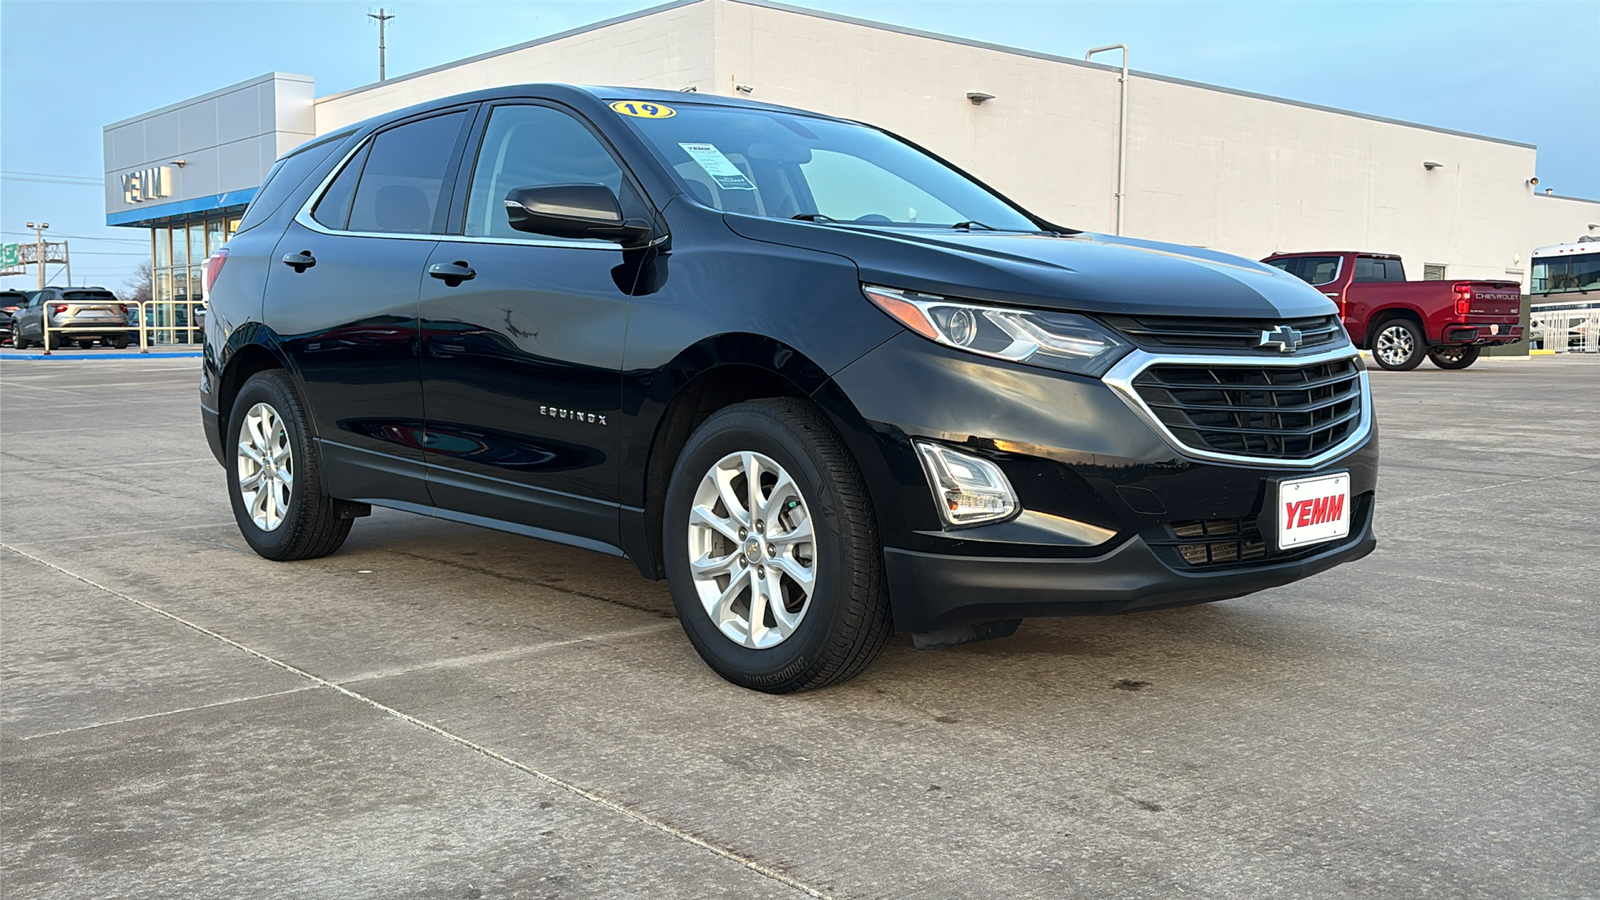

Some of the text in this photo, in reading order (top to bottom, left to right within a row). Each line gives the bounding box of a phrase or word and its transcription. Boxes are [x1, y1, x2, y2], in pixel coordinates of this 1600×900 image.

[624, 103, 659, 116] 19
[121, 166, 171, 204] YEMM
[540, 405, 607, 426] EQUINOX
[1286, 493, 1345, 530] YEMM
[743, 655, 809, 686] BRIDGESTONE
